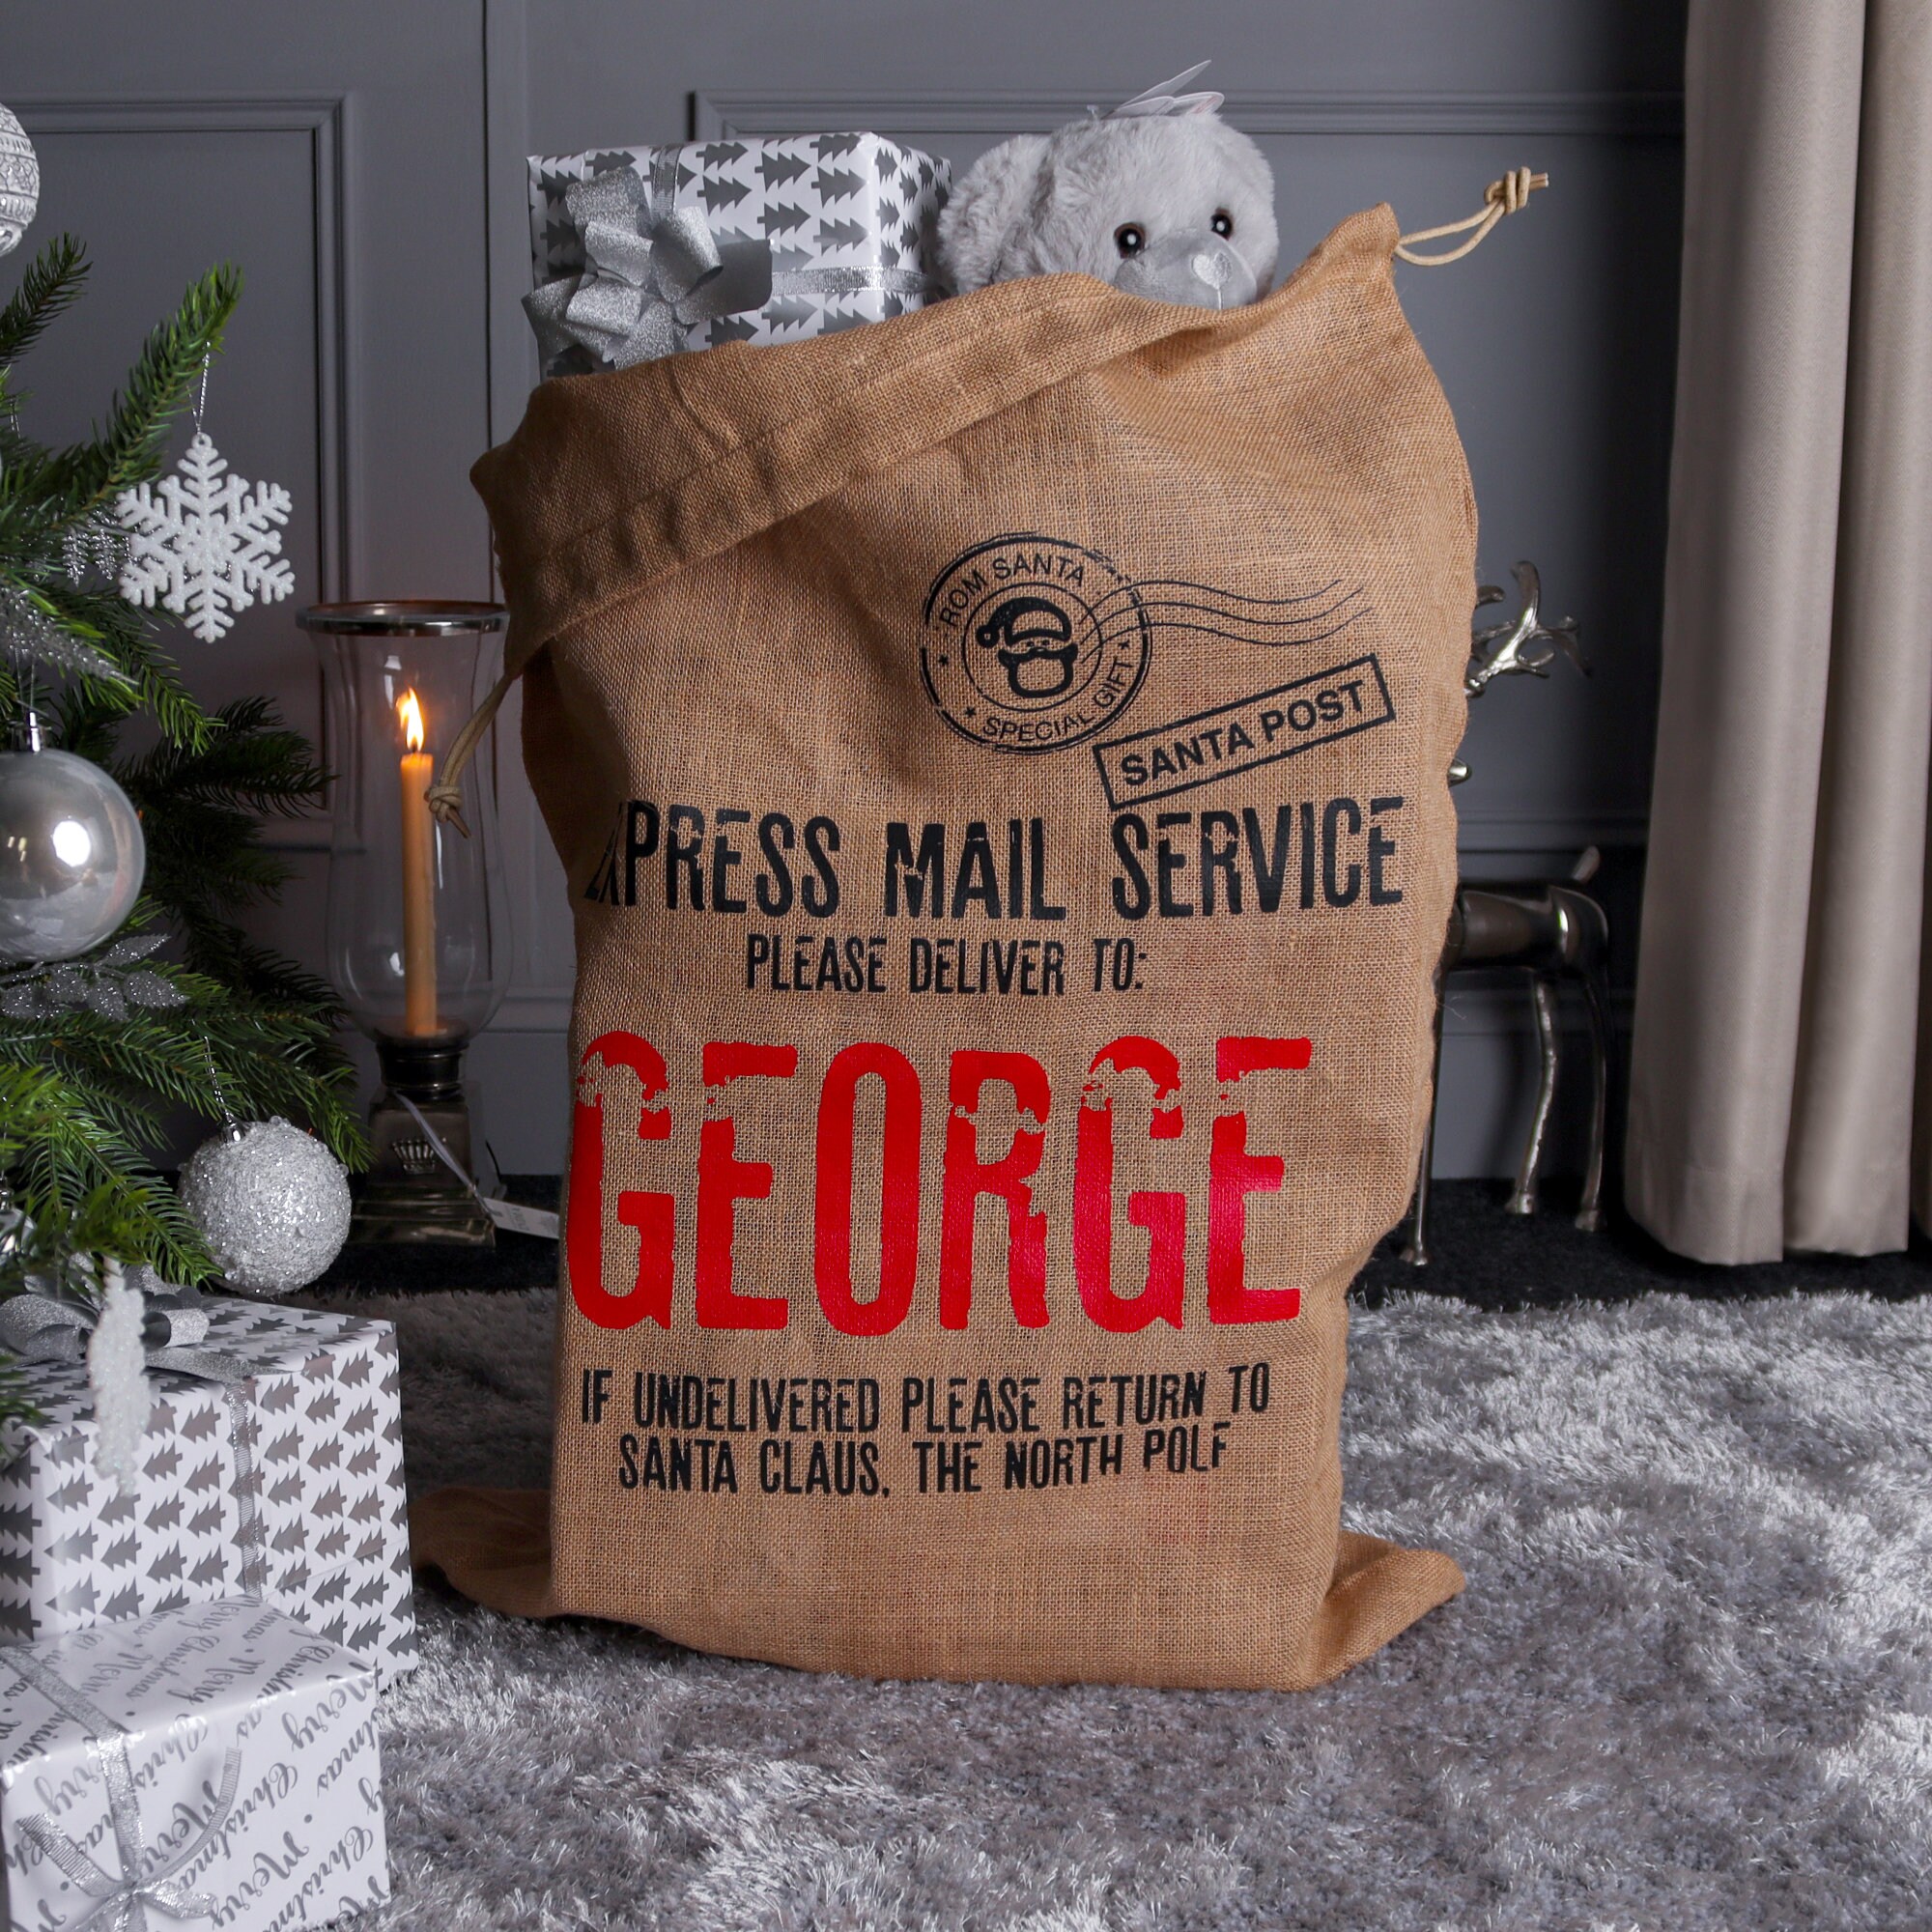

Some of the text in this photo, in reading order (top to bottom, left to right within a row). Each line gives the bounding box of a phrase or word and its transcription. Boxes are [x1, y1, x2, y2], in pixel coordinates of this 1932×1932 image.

[940, 552, 1085, 626] ROM SANTA
[982, 656, 1134, 743] SPECIAL GIFT
[1120, 679, 1365, 786] SANTA POST
[884, 817, 1066, 920] MAIL
[1112, 797, 1404, 921] SERVICE
[746, 932, 1148, 996] PLEASE DELIVER TO:
[566, 1031, 1313, 1337] GEORGE
[582, 1362, 1270, 1435] IF UNDELIVERED PLEASE RETURN TO
[618, 1434, 738, 1494] SANTA
[911, 1441, 982, 1493] THE
[1003, 1432, 1124, 1491] NORTH
[75, 1652, 155, 1700] Merr
[126, 1635, 220, 1703] Christmas
[165, 1657, 267, 1707] Merry
[281, 1661, 375, 1755] Merry
[179, 1762, 298, 1891] Christma
